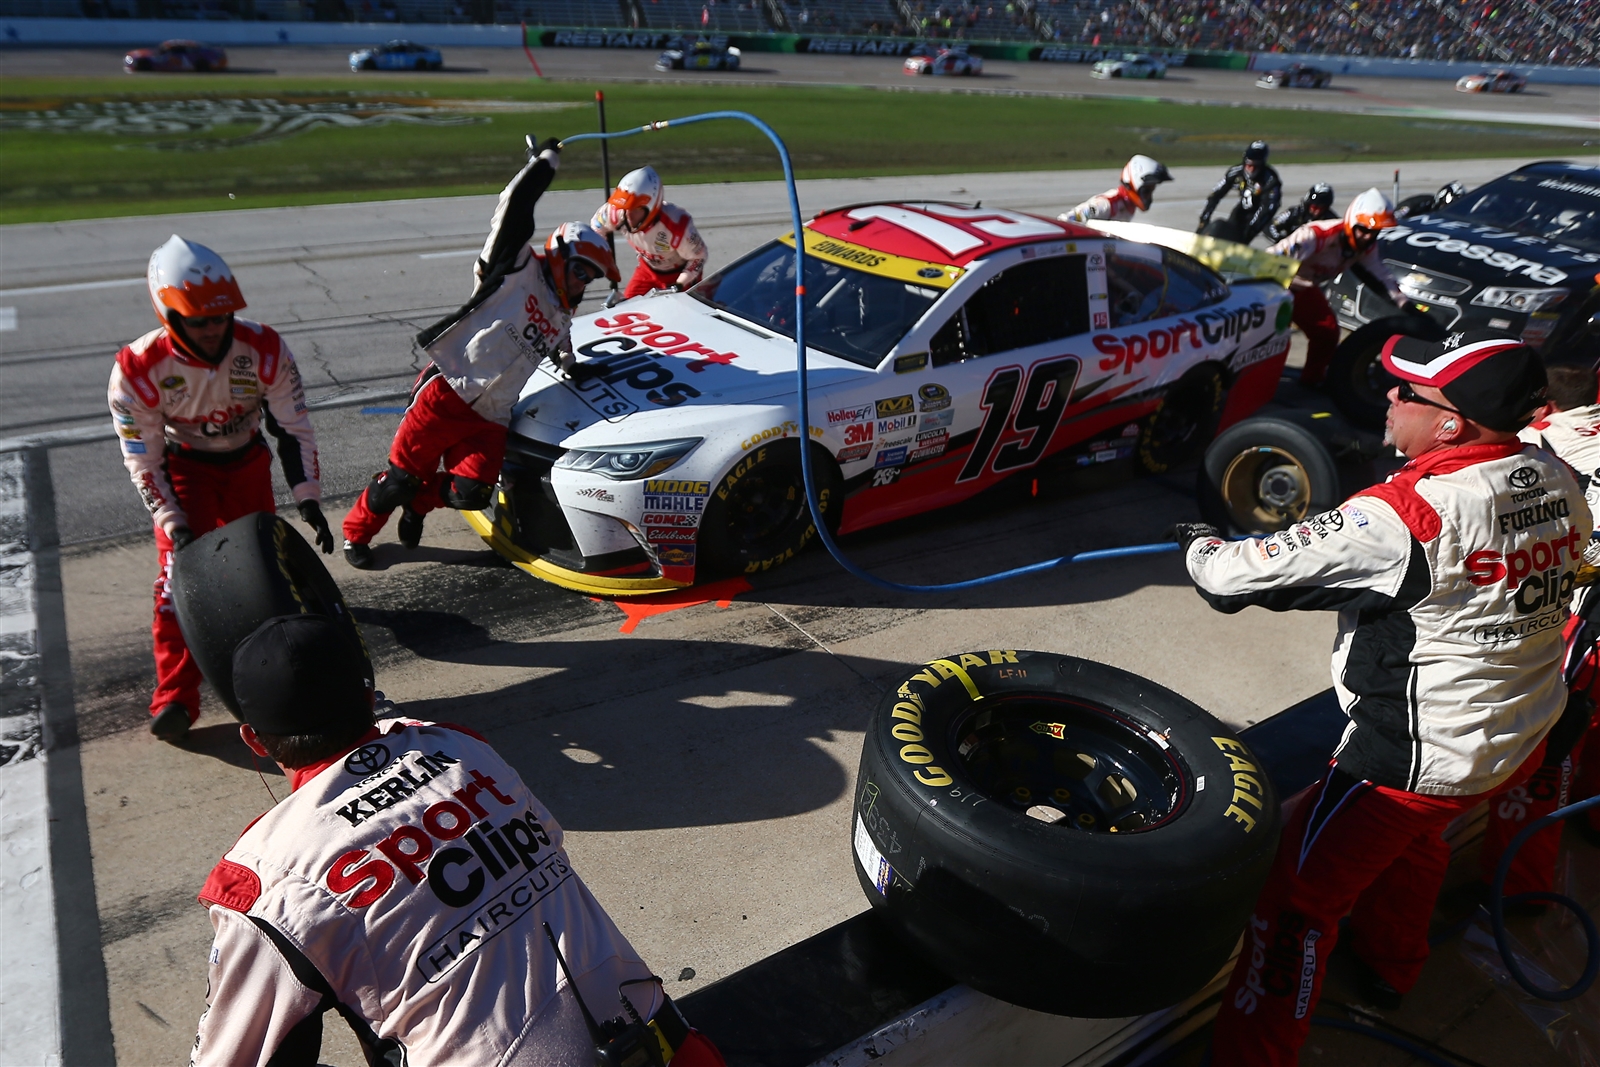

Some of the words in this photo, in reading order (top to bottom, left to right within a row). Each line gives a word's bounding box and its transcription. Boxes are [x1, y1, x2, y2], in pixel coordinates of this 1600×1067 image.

[553, 31, 662, 48] RESTART
[666, 34, 728, 50] ZNE
[807, 38, 908, 55] RESTART
[811, 240, 886, 268] EDWARDS
[1406, 231, 1568, 286] Cessna
[525, 293, 560, 344] Sport
[1092, 318, 1203, 376] Sport
[1195, 302, 1266, 344] Clips
[594, 312, 740, 373] Sport
[229, 369, 257, 378] TOYOTA
[577, 336, 702, 407] Clips
[828, 409, 856, 423] Holley
[856, 405, 872, 420] EFI
[844, 422, 873, 445] 3M
[878, 417, 906, 433] Mobil
[917, 429, 946, 441] LINCOLN
[955, 354, 1082, 484] 19
[741, 421, 824, 450] GOODYAR
[883, 436, 913, 448] freescale
[645, 479, 709, 495] MOOG
[717, 448, 767, 500] EAGLE
[1511, 486, 1549, 504] TOYOTA
[643, 514, 687, 525] COMP
[644, 496, 704, 510] MAHLE
[1498, 498, 1570, 535] FURINO
[648, 529, 696, 541] Edelbrock
[1306, 516, 1329, 540] OYOTA
[1464, 525, 1581, 591] Sport
[1514, 568, 1575, 615] Clip
[1483, 612, 1562, 641] HAIRCU
[892, 650, 1020, 787] GOODYEAR
[336, 750, 461, 828] KERLIN
[1211, 736, 1265, 833] EAGLE
[326, 769, 517, 909] Sport
[428, 809, 551, 909] Clips
[428, 857, 569, 973] HAIRCUTS
[1234, 913, 1268, 1015] Sport
[1262, 910, 1305, 998] Clips
[1297, 932, 1319, 1016] HAIRCUTS
